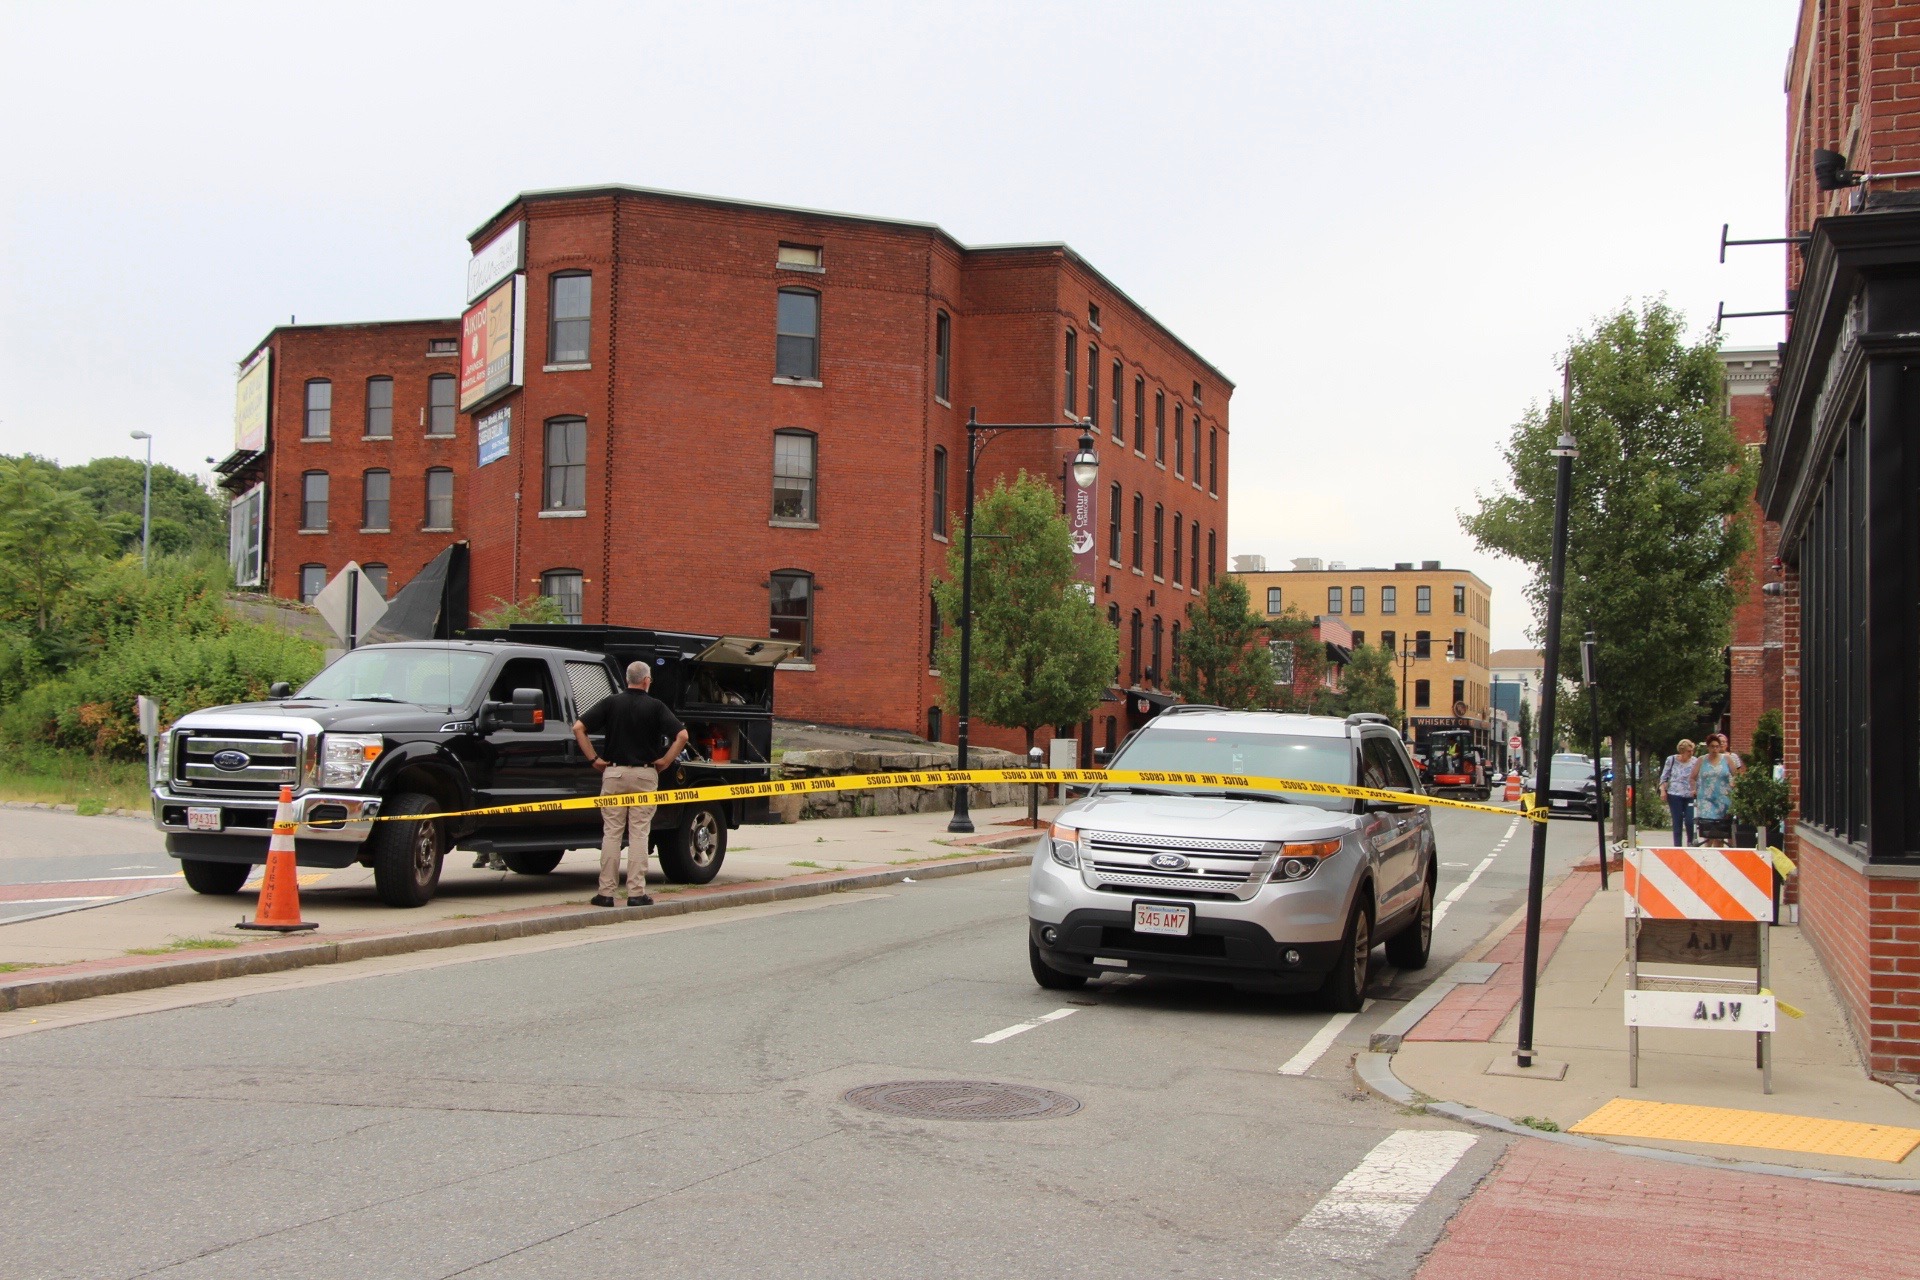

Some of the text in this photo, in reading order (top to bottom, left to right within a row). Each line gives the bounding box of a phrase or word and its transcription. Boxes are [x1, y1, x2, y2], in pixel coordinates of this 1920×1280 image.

[464, 308, 487, 337] AIKIDO
[1075, 488, 1088, 528] Century
[1418, 719, 1456, 727] WHISKEY
[866, 772, 971, 785] POLICE LINE DO NOT CROSS
[1001, 771, 1108, 780] POLICE LINE DO NOT CROSS
[1139, 772, 1249, 786] POLICE LINE DO NOT CROSS
[730, 779, 836, 796] POLICE LINE DO NOT CROSS
[1280, 780, 1308, 791] CROSS
[1309, 783, 1327, 792] NOT
[1327, 785, 1340, 794] DO
[594, 790, 699, 807] POLICE LINE DO NOT CROSS
[518, 805, 533, 813] LINE
[538, 802, 562, 812] POLICE
[1138, 912, 1186, 929] 345 AM7
[1687, 932, 1733, 951] AJV
[1693, 1000, 1742, 1022] AJV
